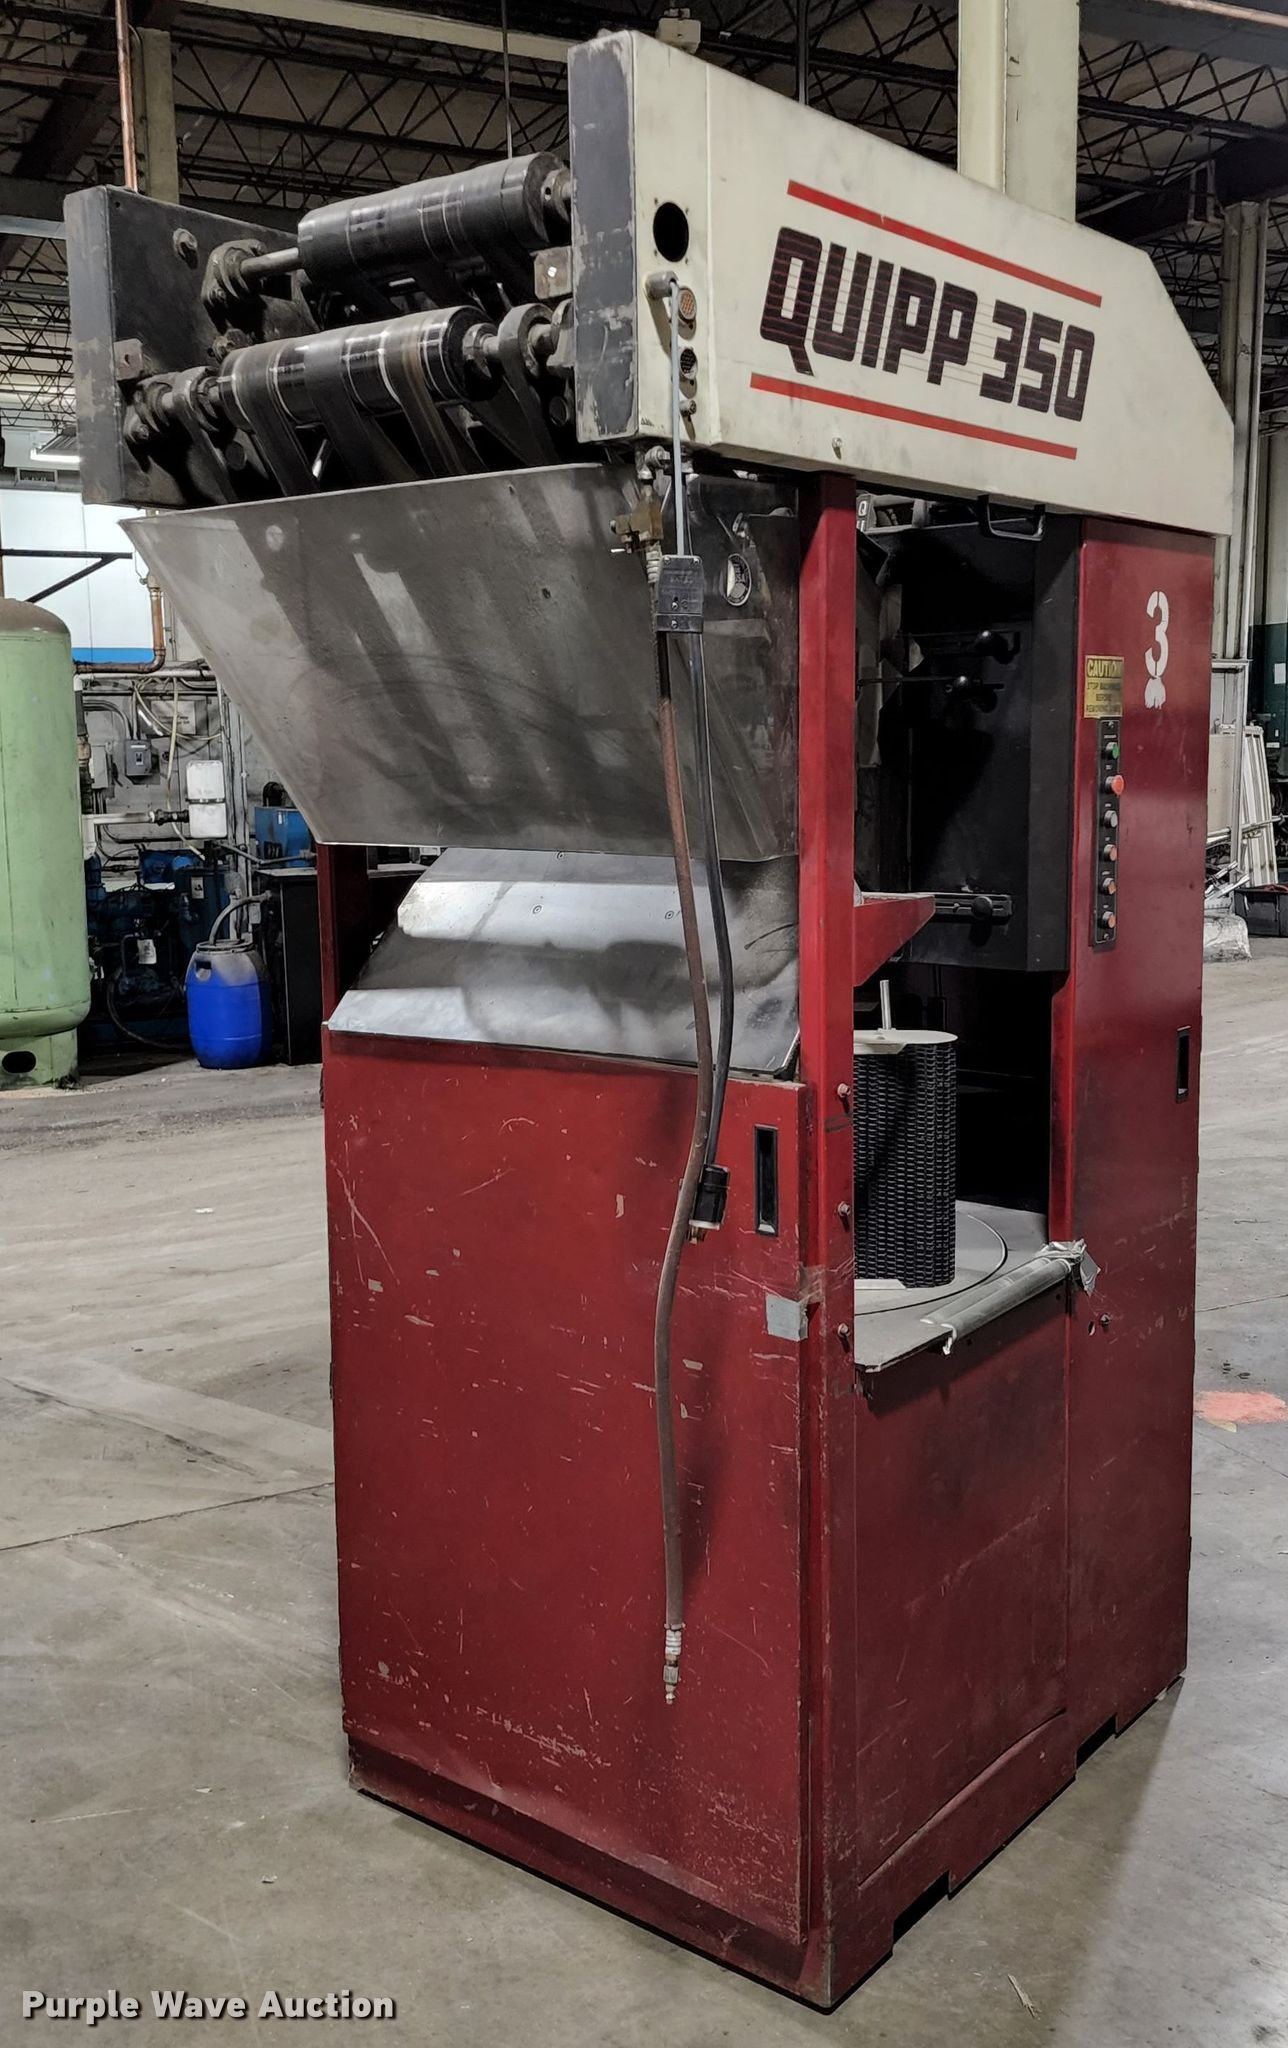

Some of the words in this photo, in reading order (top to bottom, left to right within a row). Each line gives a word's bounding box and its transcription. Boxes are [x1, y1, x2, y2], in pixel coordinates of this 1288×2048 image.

[760, 227, 978, 386] QUIPP
[979, 299, 1095, 422] 350
[1145, 590, 1169, 677] 3
